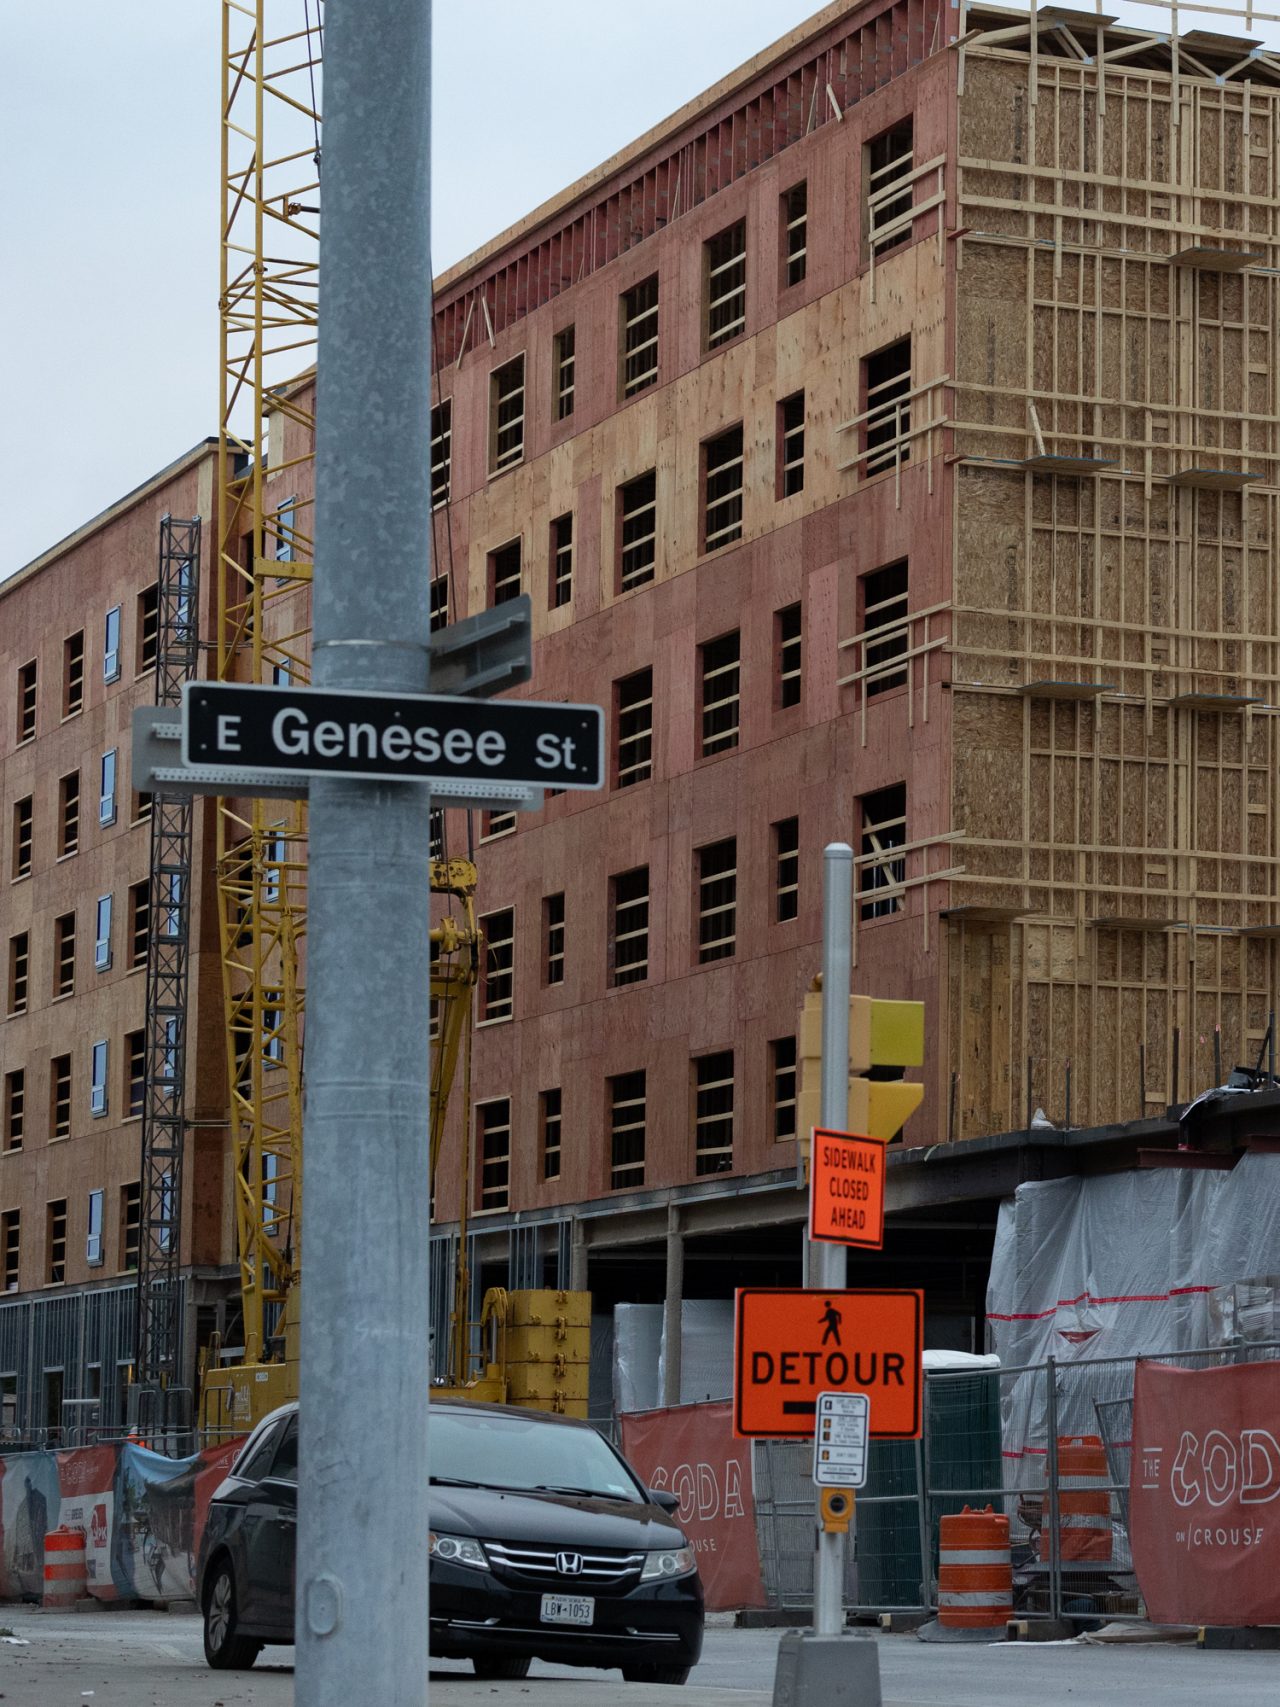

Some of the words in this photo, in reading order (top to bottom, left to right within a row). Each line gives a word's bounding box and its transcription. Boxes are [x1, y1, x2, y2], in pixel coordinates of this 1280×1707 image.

[217, 714, 242, 751] E
[271, 706, 506, 767] Genesee
[535, 732, 576, 770] St
[823, 1146, 876, 1174] SIDEWALK
[829, 1176, 869, 1201] CLOSED
[830, 1209, 866, 1231] AHEAD
[751, 1351, 905, 1386] DETOUR
[1142, 1458, 1161, 1478] THE
